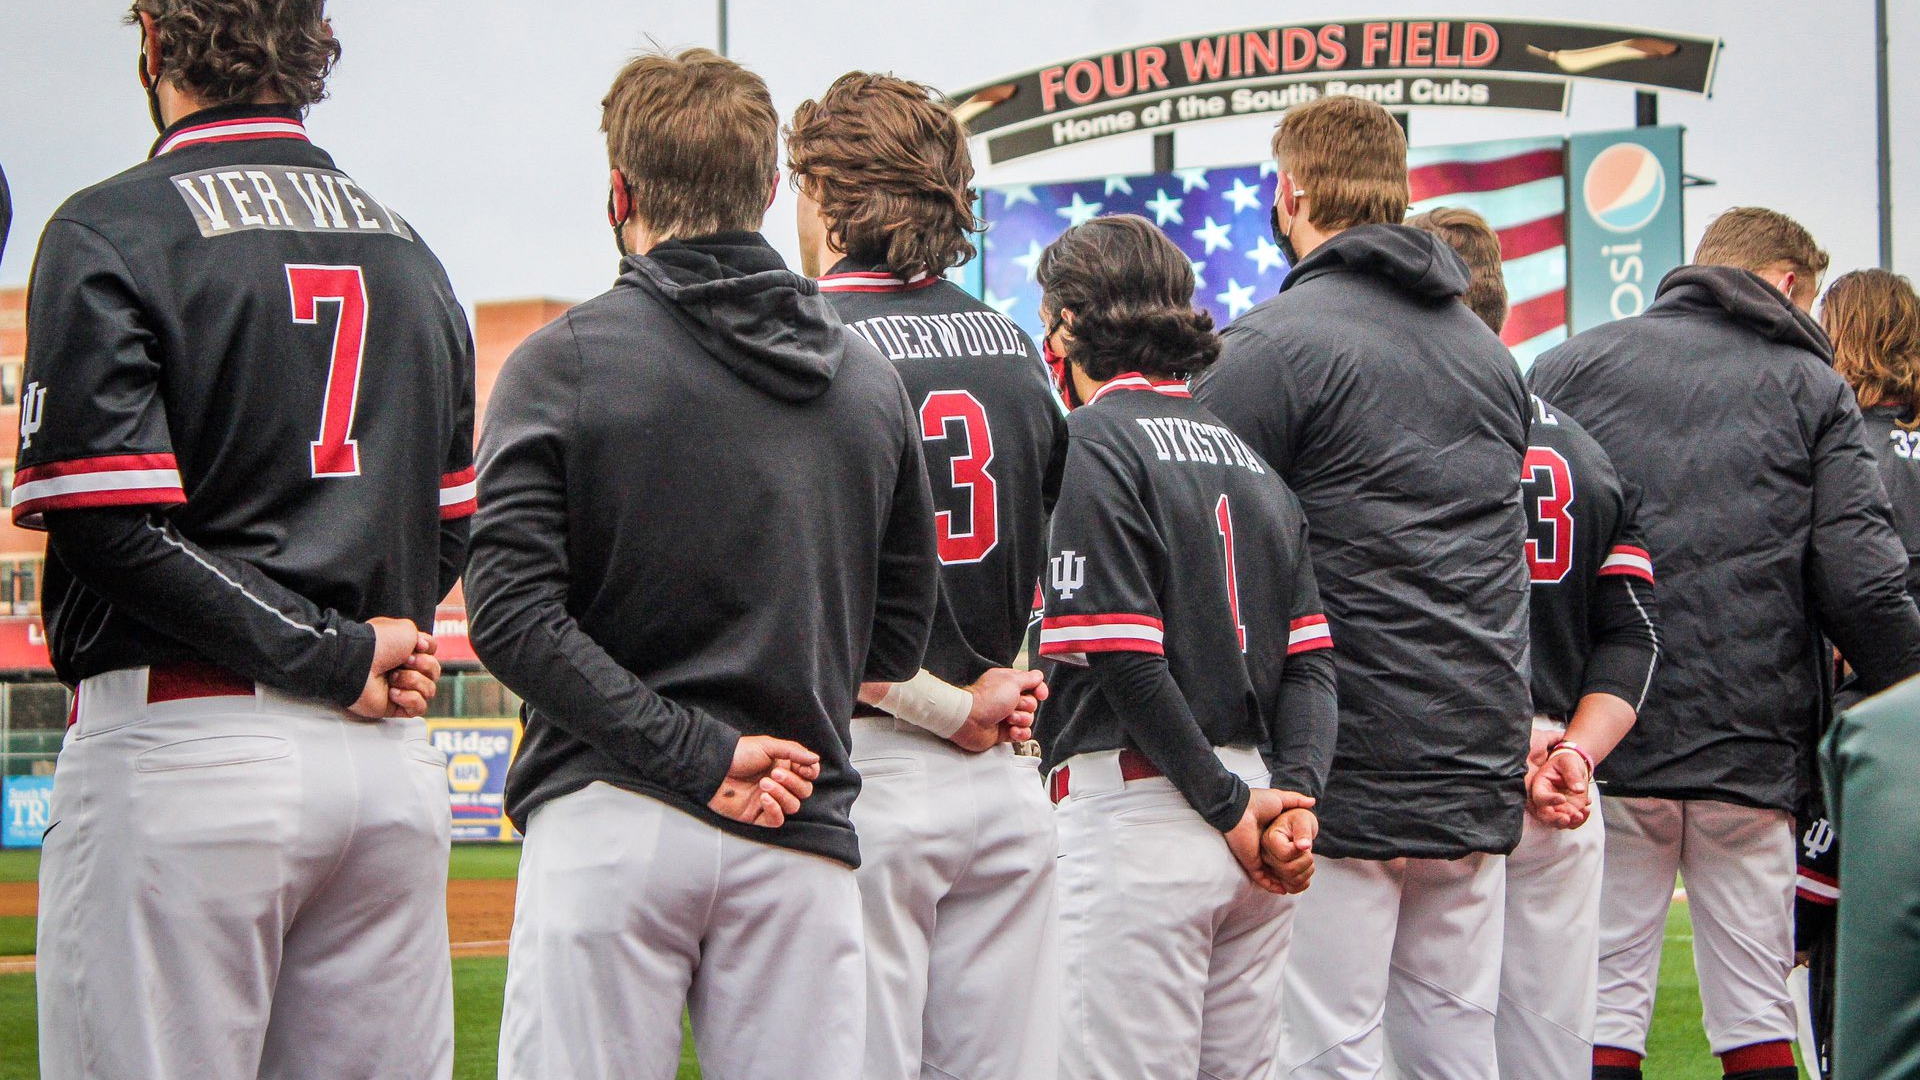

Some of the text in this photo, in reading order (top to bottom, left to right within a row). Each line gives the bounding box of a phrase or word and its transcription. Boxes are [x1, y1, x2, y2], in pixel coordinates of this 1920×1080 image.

[1039, 21, 1500, 112] FOUR WINDS FIELD
[1051, 109, 1136, 146] Home
[1140, 99, 1173, 127] of
[1176, 95, 1226, 121] the
[1231, 82, 1318, 113] South
[1409, 78, 1490, 105] Cubs
[177, 170, 294, 231] VER
[284, 263, 369, 478] 7
[919, 389, 999, 566] 3
[1135, 416, 1265, 475] DYKSTRA
[1890, 429, 1920, 461] 32
[1520, 446, 1574, 584] 3
[1215, 493, 1246, 653] 1
[433, 731, 510, 760] Ridge
